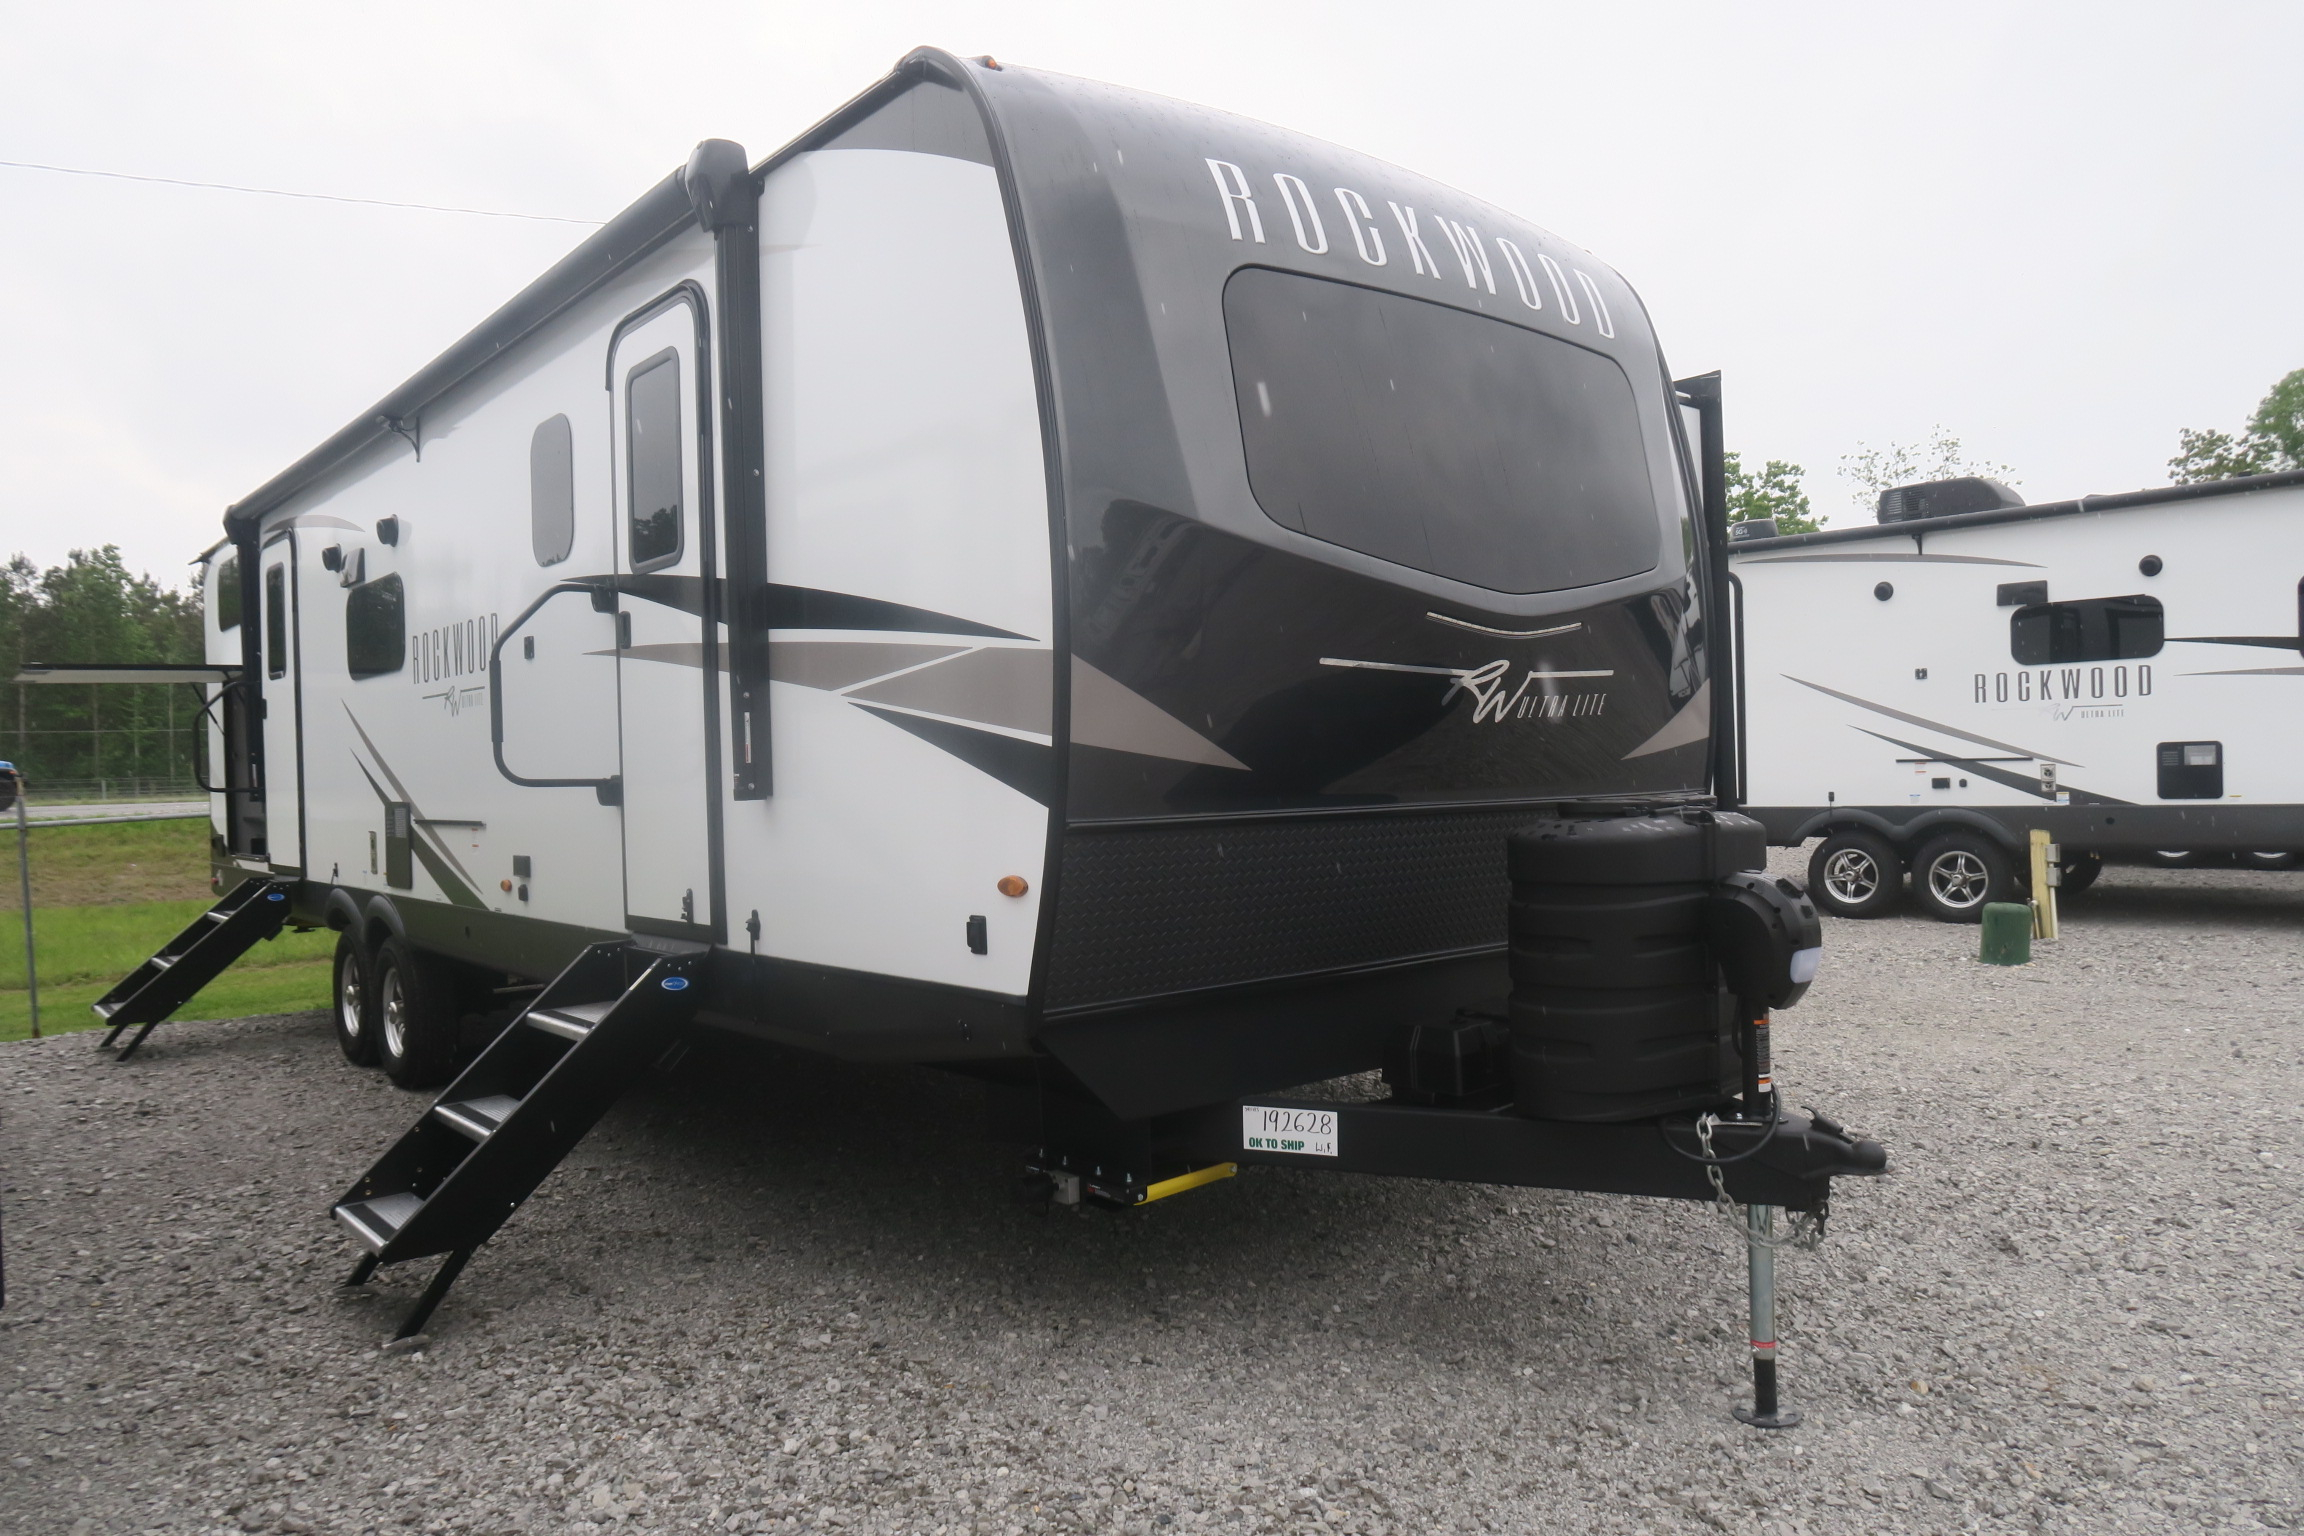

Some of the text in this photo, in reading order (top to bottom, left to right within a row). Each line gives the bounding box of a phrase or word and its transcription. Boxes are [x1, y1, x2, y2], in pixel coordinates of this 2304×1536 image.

[1204, 157, 1615, 339] ROCKWOOD
[1974, 664, 2152, 704] ROCKWOOD
[1516, 694, 1569, 719] ULTRA
[1572, 693, 1607, 717] LITE
[1263, 1109, 1332, 1135] 192628
[1248, 1136, 1305, 1151] OK TO SHIP
